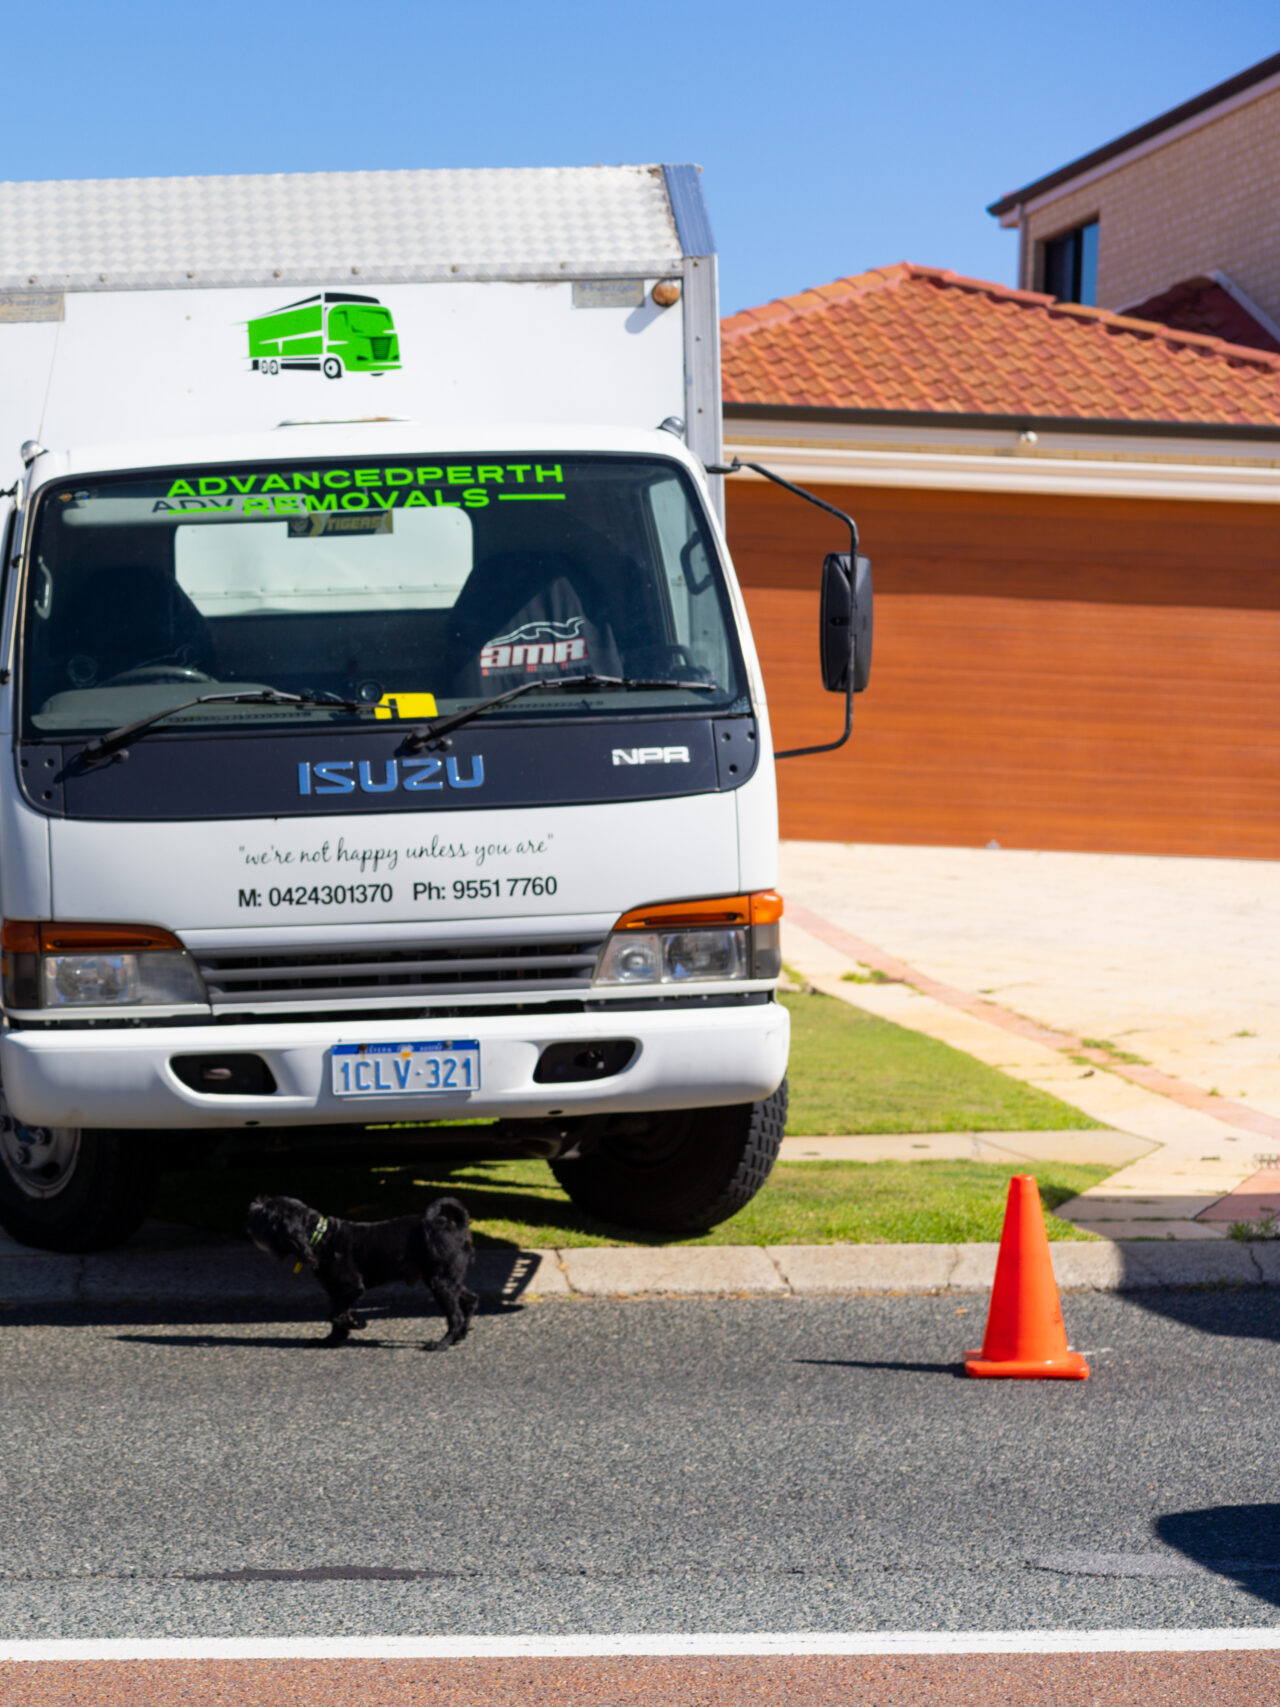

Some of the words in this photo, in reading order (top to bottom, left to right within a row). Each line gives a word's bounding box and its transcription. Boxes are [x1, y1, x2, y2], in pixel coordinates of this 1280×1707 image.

[243, 488, 490, 518] REMOVALS
[324, 514, 383, 531] TIGERS
[612, 746, 691, 766] NPR
[298, 755, 485, 795] ISUZU
[298, 838, 331, 863] not
[336, 836, 399, 873] happy
[405, 834, 469, 861] unless
[473, 842, 512, 868] you
[238, 888, 262, 908] M:
[268, 883, 393, 907] 0424301370
[412, 881, 446, 902] Ph:
[453, 878, 501, 900] 9551
[506, 875, 558, 898] 7760
